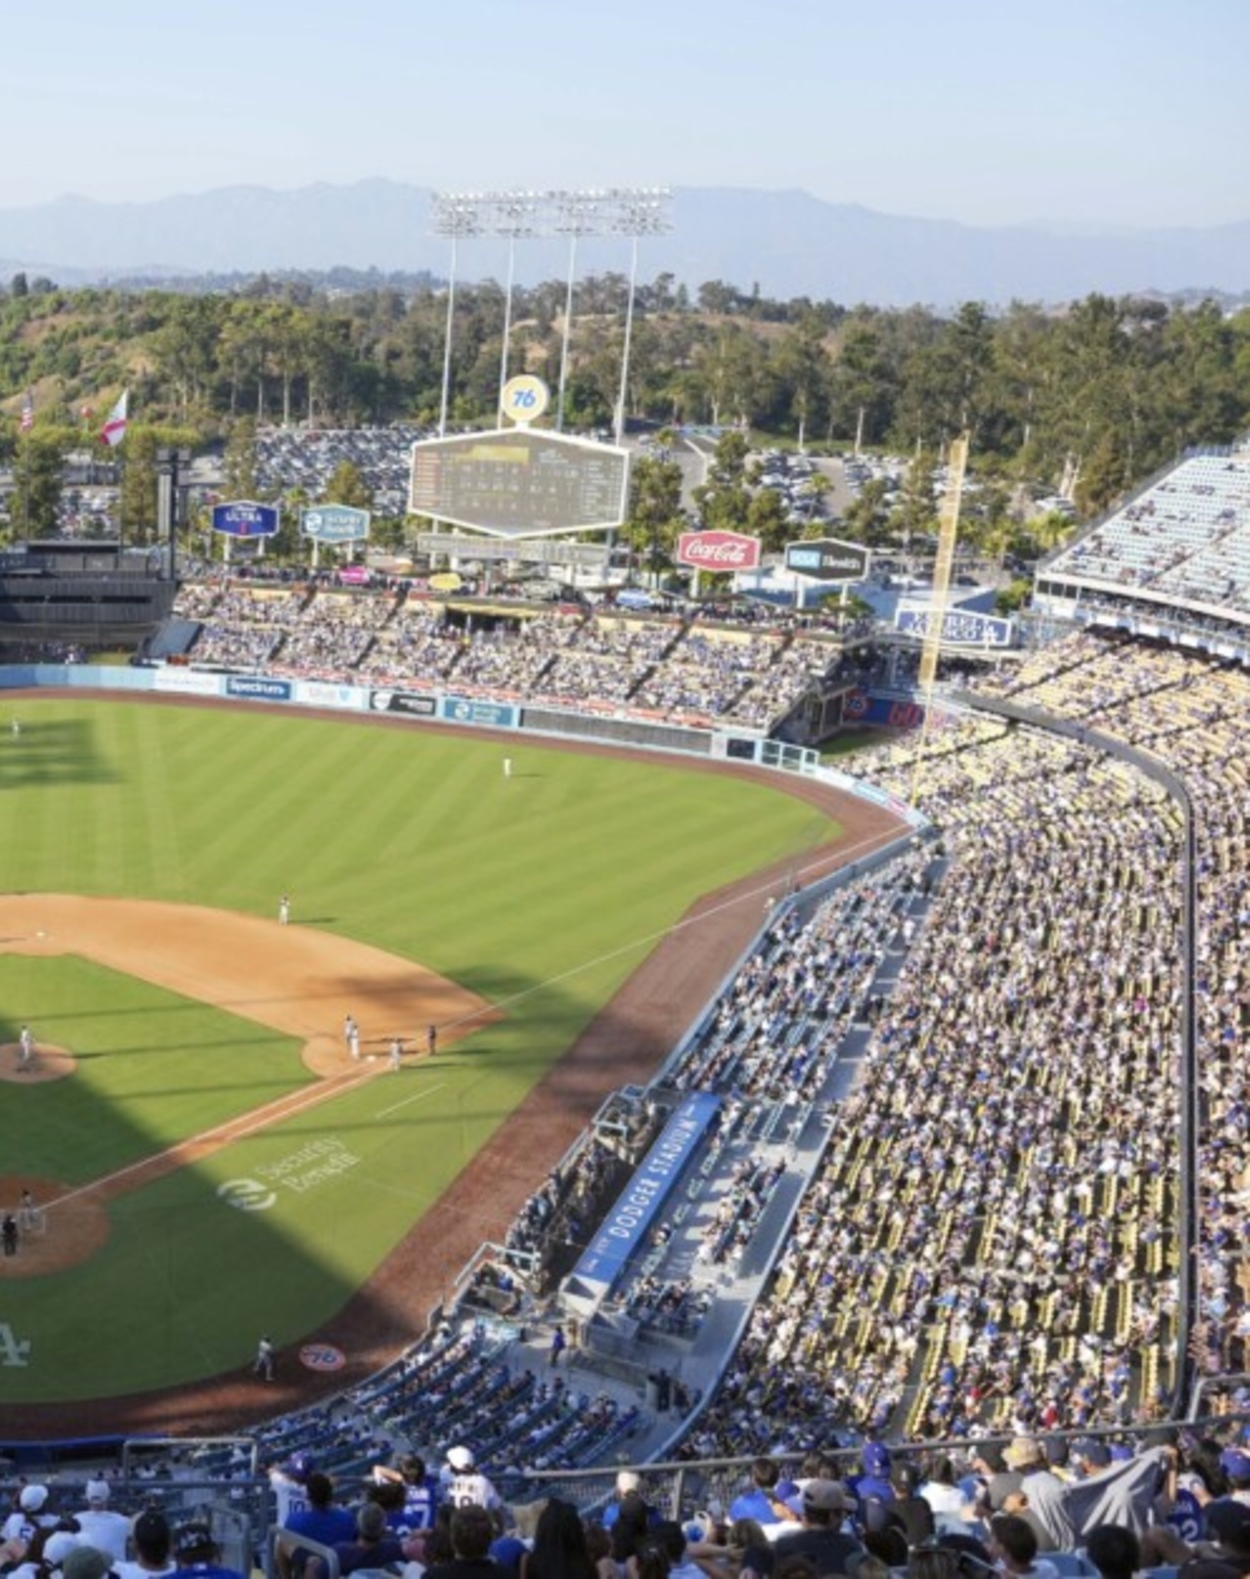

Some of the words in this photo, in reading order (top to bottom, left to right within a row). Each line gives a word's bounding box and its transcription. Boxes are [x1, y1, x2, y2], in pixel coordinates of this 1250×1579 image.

[514, 389, 537, 408] 76
[225, 511, 263, 522] ULTRA
[686, 540, 747, 562] Coca-Cola
[230, 679, 281, 695] Spectrum
[255, 1136, 346, 1180] Security
[281, 1153, 361, 1192] Benefit
[607, 1177, 661, 1239] DODGER
[647, 1117, 700, 1176] STADIUM
[303, 1349, 338, 1364] 76
